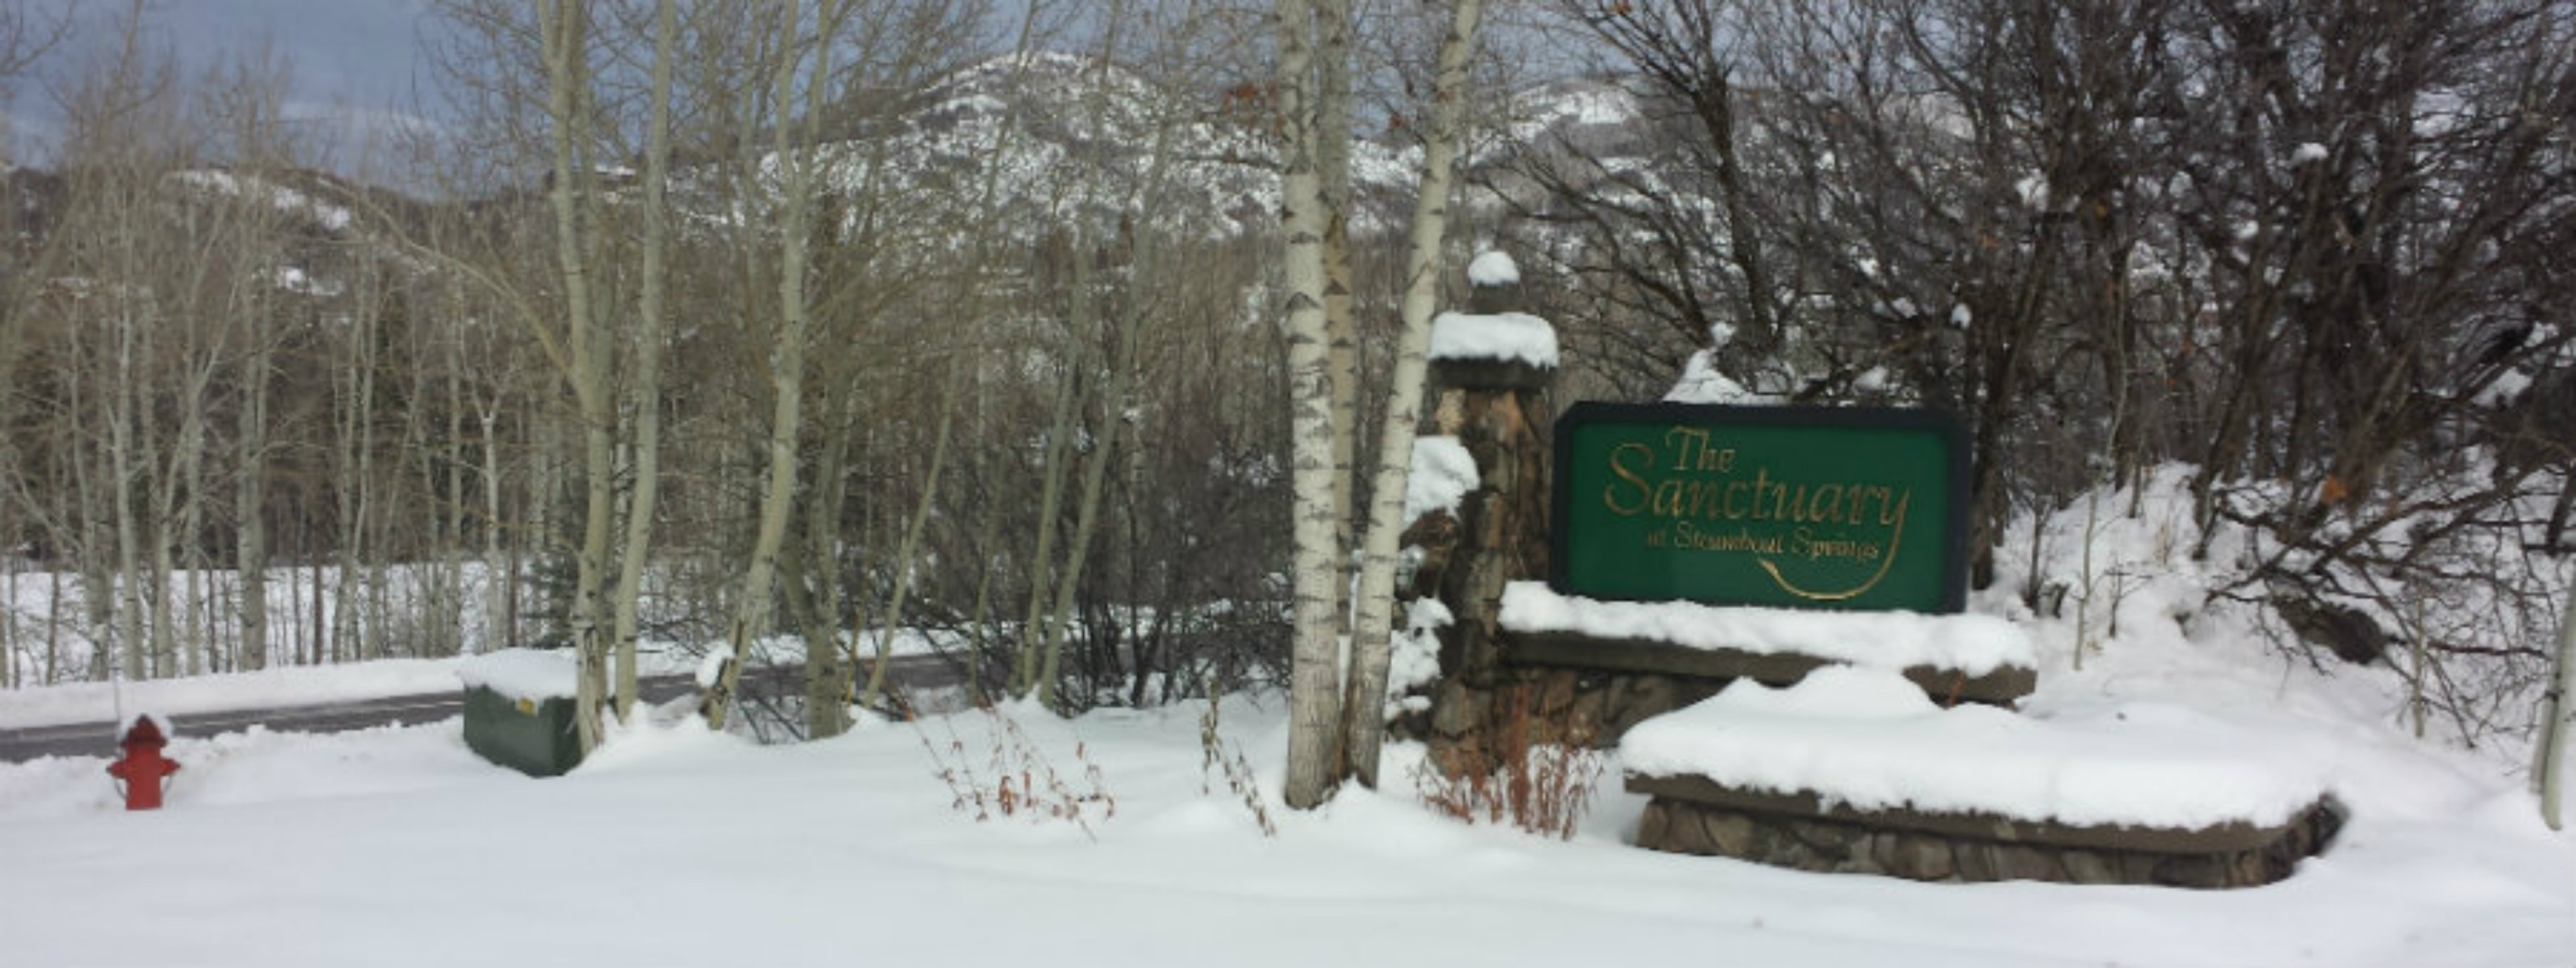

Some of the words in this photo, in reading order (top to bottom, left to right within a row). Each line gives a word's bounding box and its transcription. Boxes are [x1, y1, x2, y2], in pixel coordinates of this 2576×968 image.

[1666, 426, 1735, 473] The
[1603, 442, 1911, 600] Sanctuary
[1674, 520, 1784, 554] Steamboat
[1791, 526, 1879, 563] Springs
